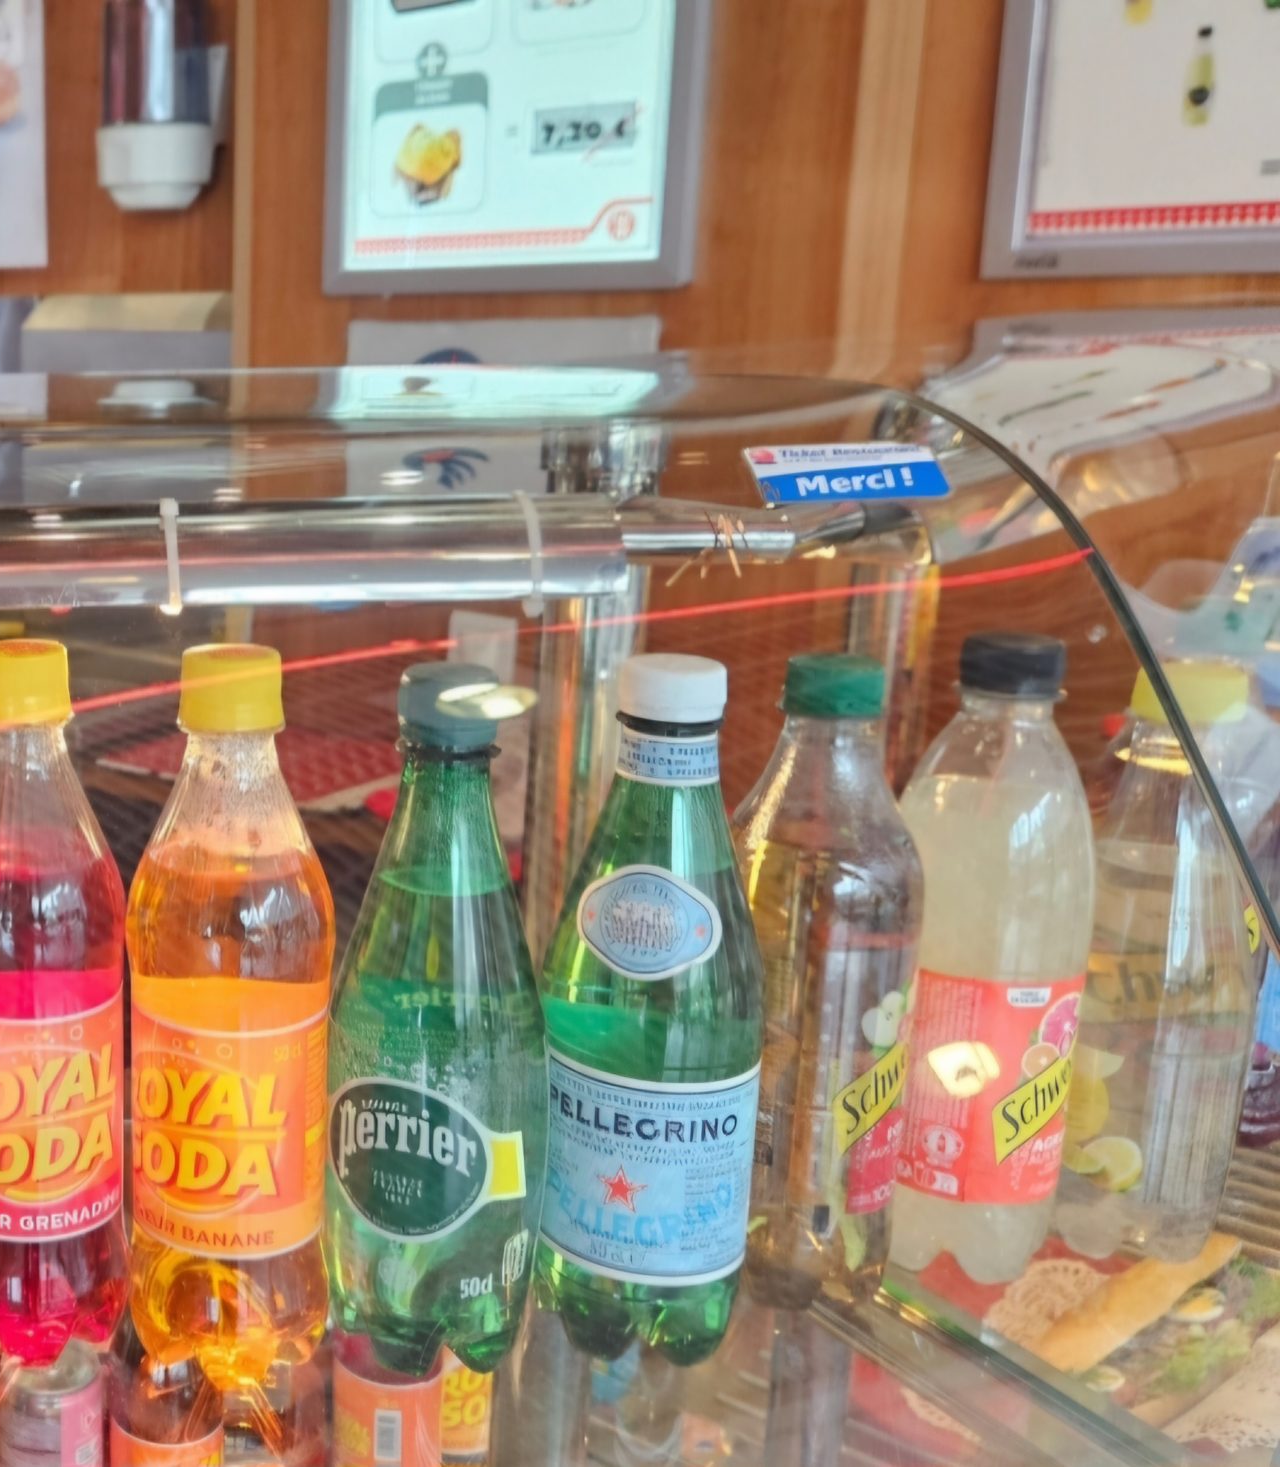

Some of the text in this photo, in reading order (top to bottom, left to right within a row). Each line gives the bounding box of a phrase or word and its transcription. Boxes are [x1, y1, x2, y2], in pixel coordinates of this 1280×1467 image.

[795, 467, 896, 497] Merci
[842, 1052, 906, 1135] Schw
[181, 1225, 275, 1247] BANANE
